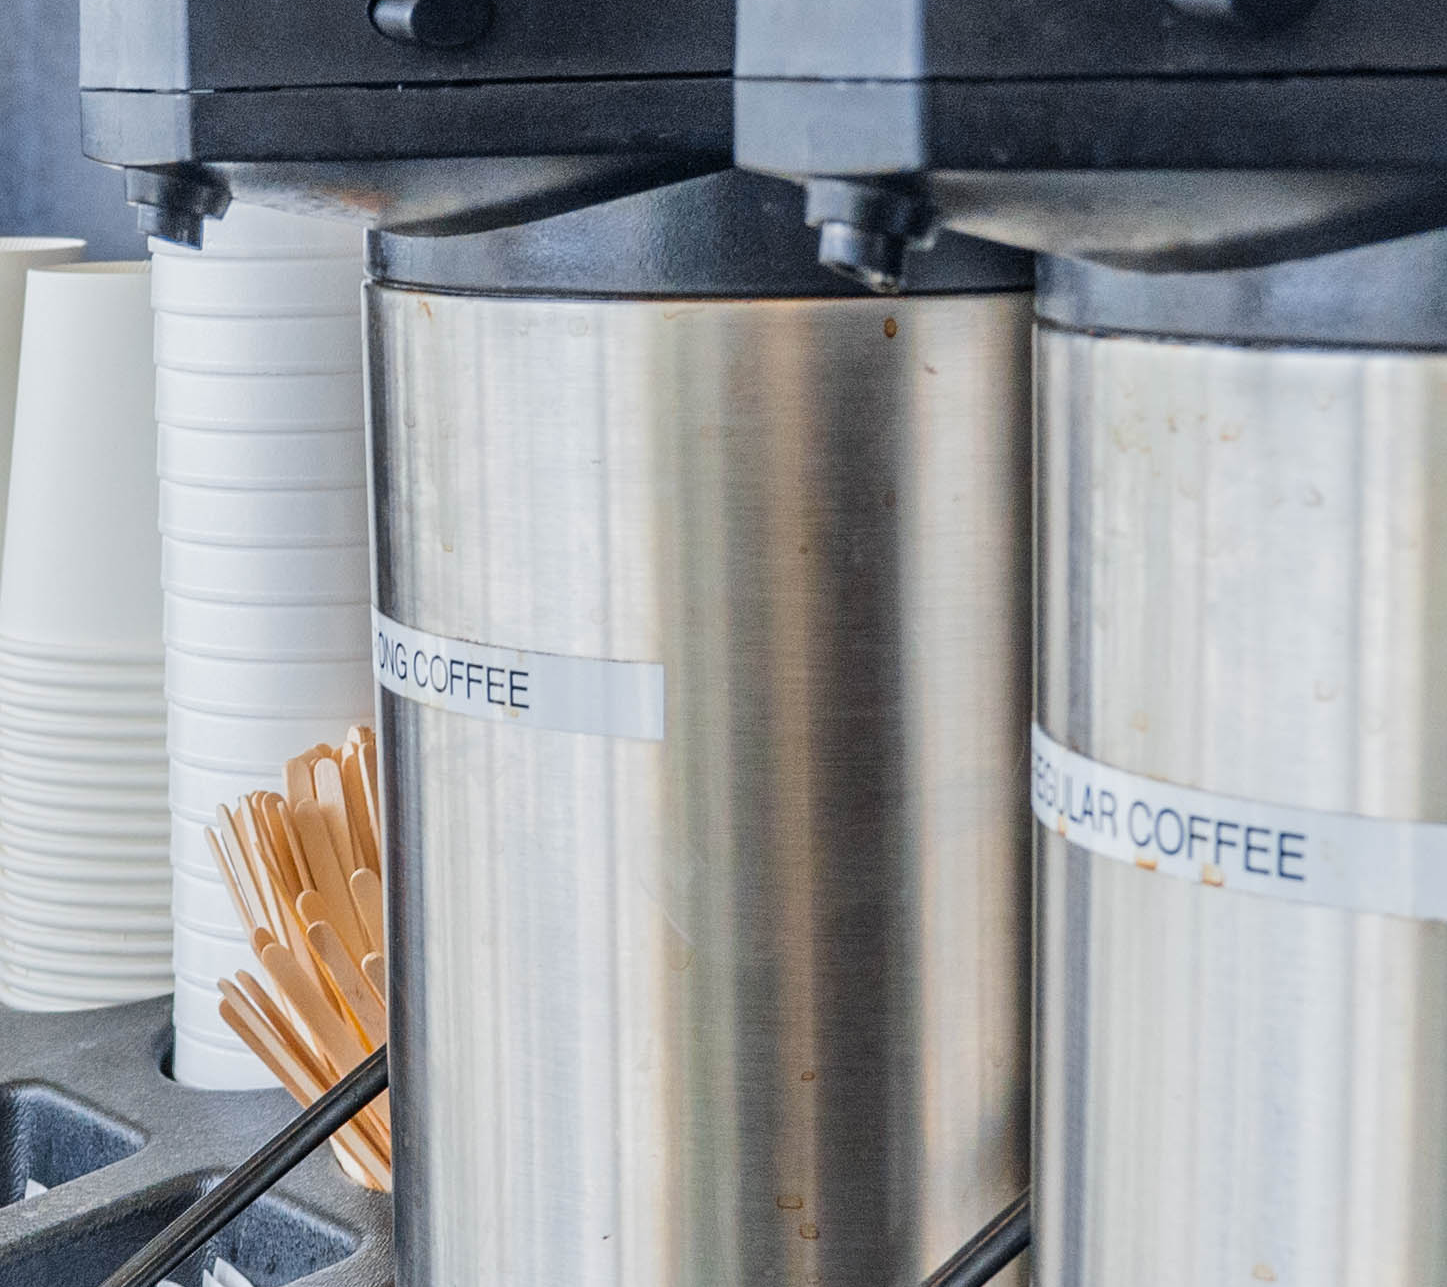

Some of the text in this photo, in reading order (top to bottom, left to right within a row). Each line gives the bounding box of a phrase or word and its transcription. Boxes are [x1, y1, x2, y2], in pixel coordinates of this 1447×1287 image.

[374, 628, 530, 709] ONG COFFEE
[1127, 799, 1308, 882] COFFEE
